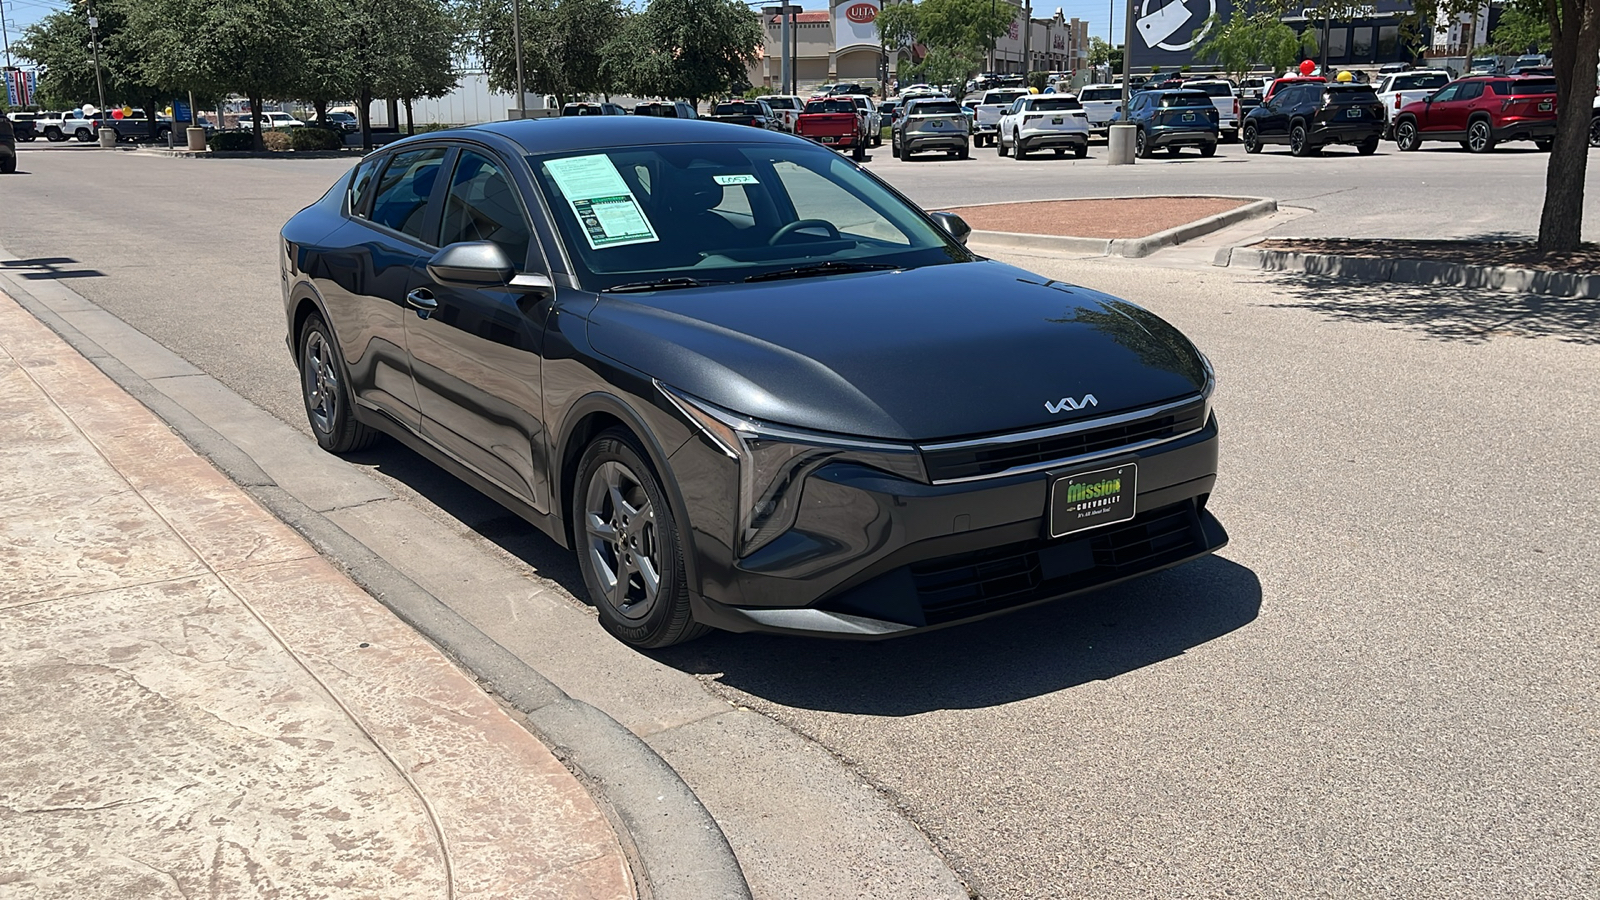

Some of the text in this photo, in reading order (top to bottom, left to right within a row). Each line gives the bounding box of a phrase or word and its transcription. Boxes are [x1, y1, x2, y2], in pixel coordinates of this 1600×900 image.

[851, 7, 875, 16] ULTA
[1076, 495, 1121, 511] CHEVROLET
[616, 623, 649, 639] KUMHO
